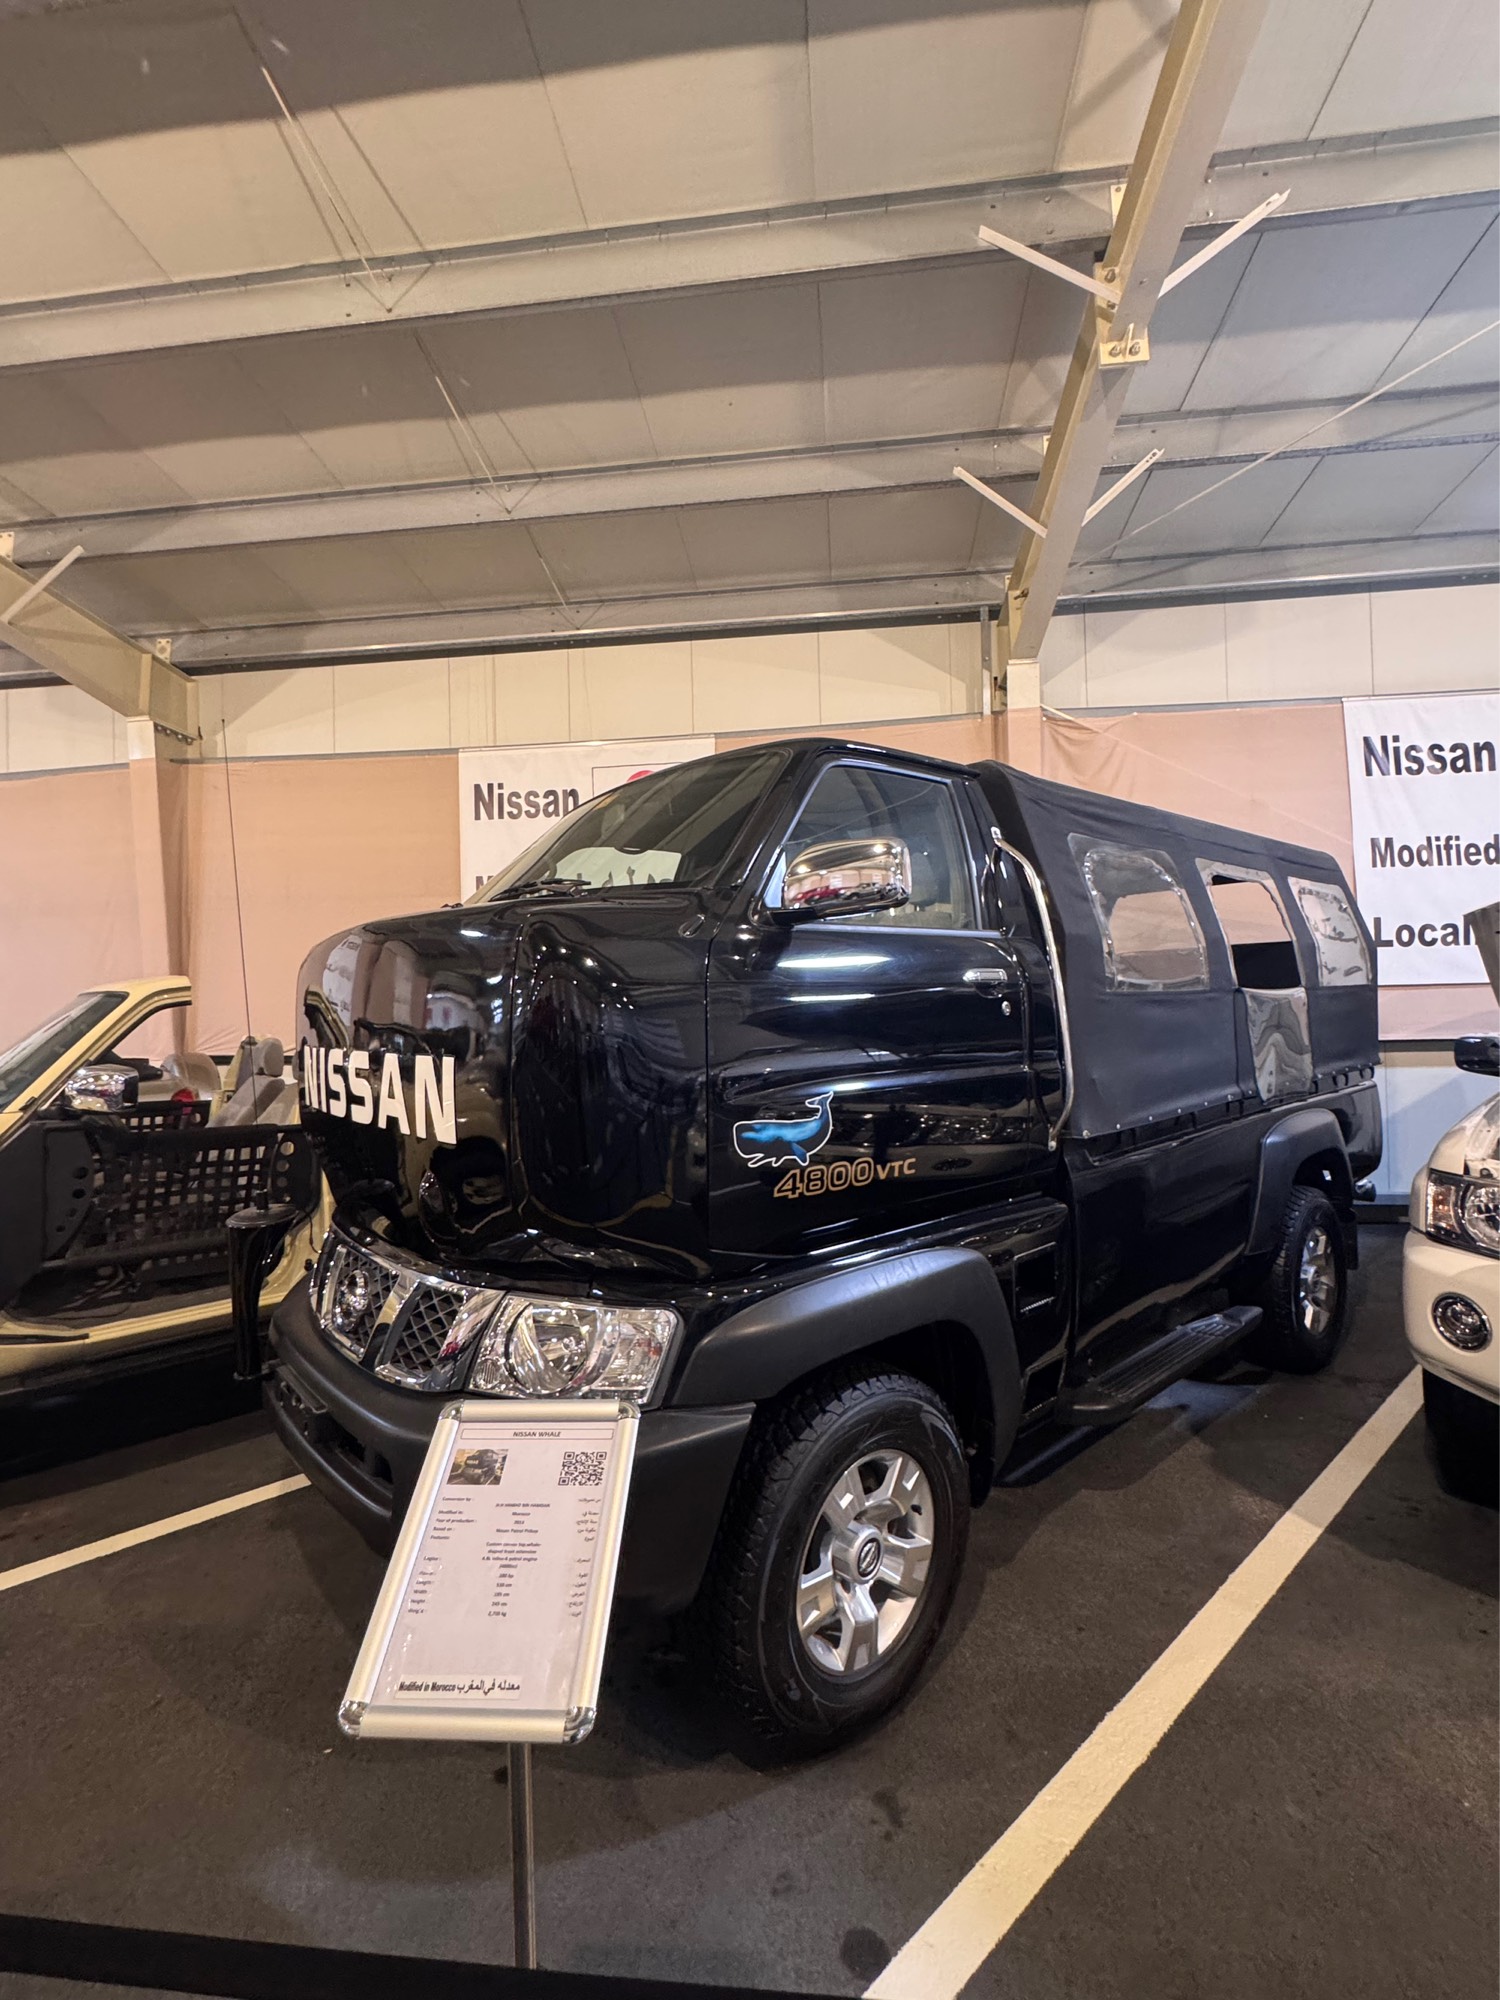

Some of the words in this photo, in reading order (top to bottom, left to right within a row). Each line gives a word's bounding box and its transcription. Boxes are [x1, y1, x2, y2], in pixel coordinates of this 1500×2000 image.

[1363, 735, 1496, 777] Nissan
[473, 783, 580, 820] Nissan
[1370, 834, 1500, 868] Modified
[304, 1045, 457, 1144] NISSAN
[773, 1157, 874, 1199] 4800
[876, 1158, 916, 1180] VTC
[399, 1681, 424, 1691] Modified
[430, 1681, 456, 1692] Morocco
